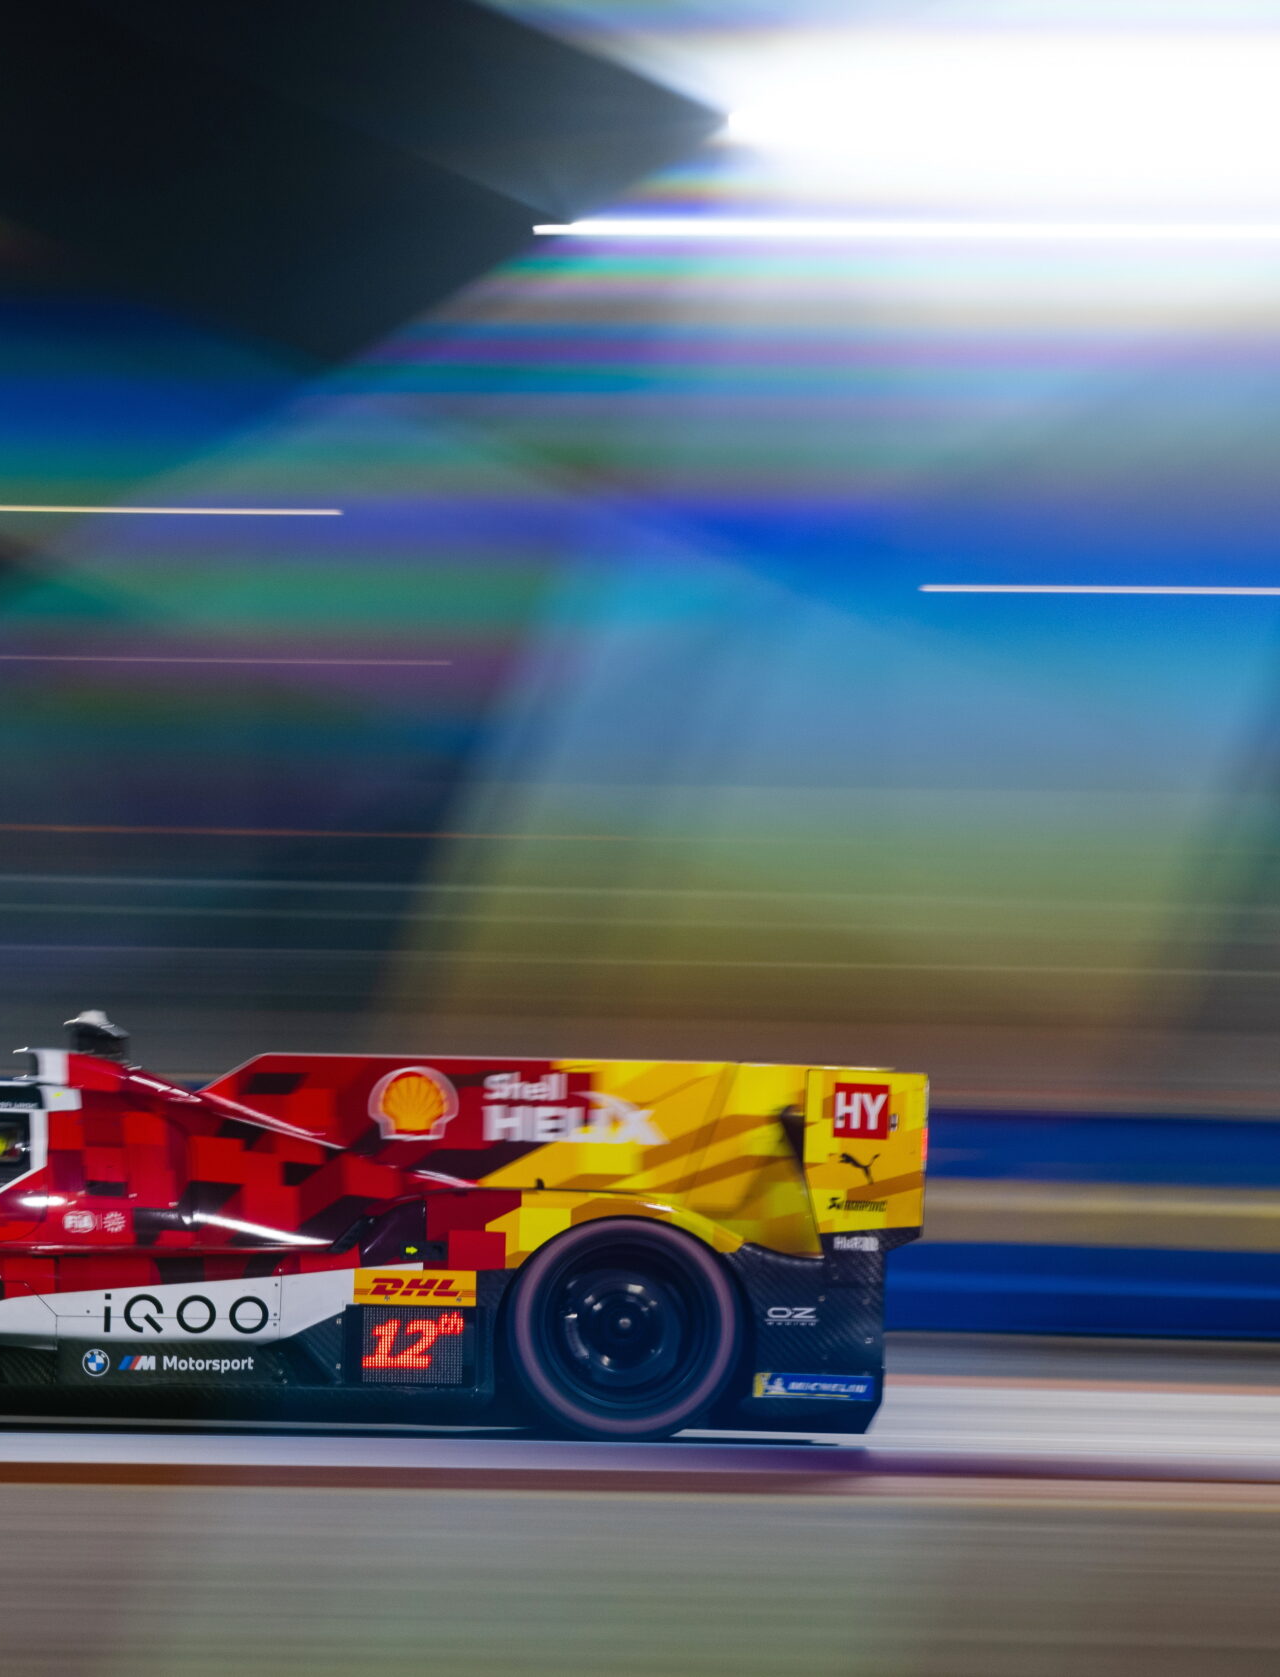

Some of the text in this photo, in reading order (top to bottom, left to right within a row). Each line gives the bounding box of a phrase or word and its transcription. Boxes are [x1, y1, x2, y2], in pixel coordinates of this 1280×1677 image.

[483, 1072, 567, 1100] Shell
[835, 1092, 887, 1130] HY
[370, 1278, 460, 1296] DHL
[104, 1293, 269, 1334] iQOO
[163, 1355, 255, 1374] Motorsport
